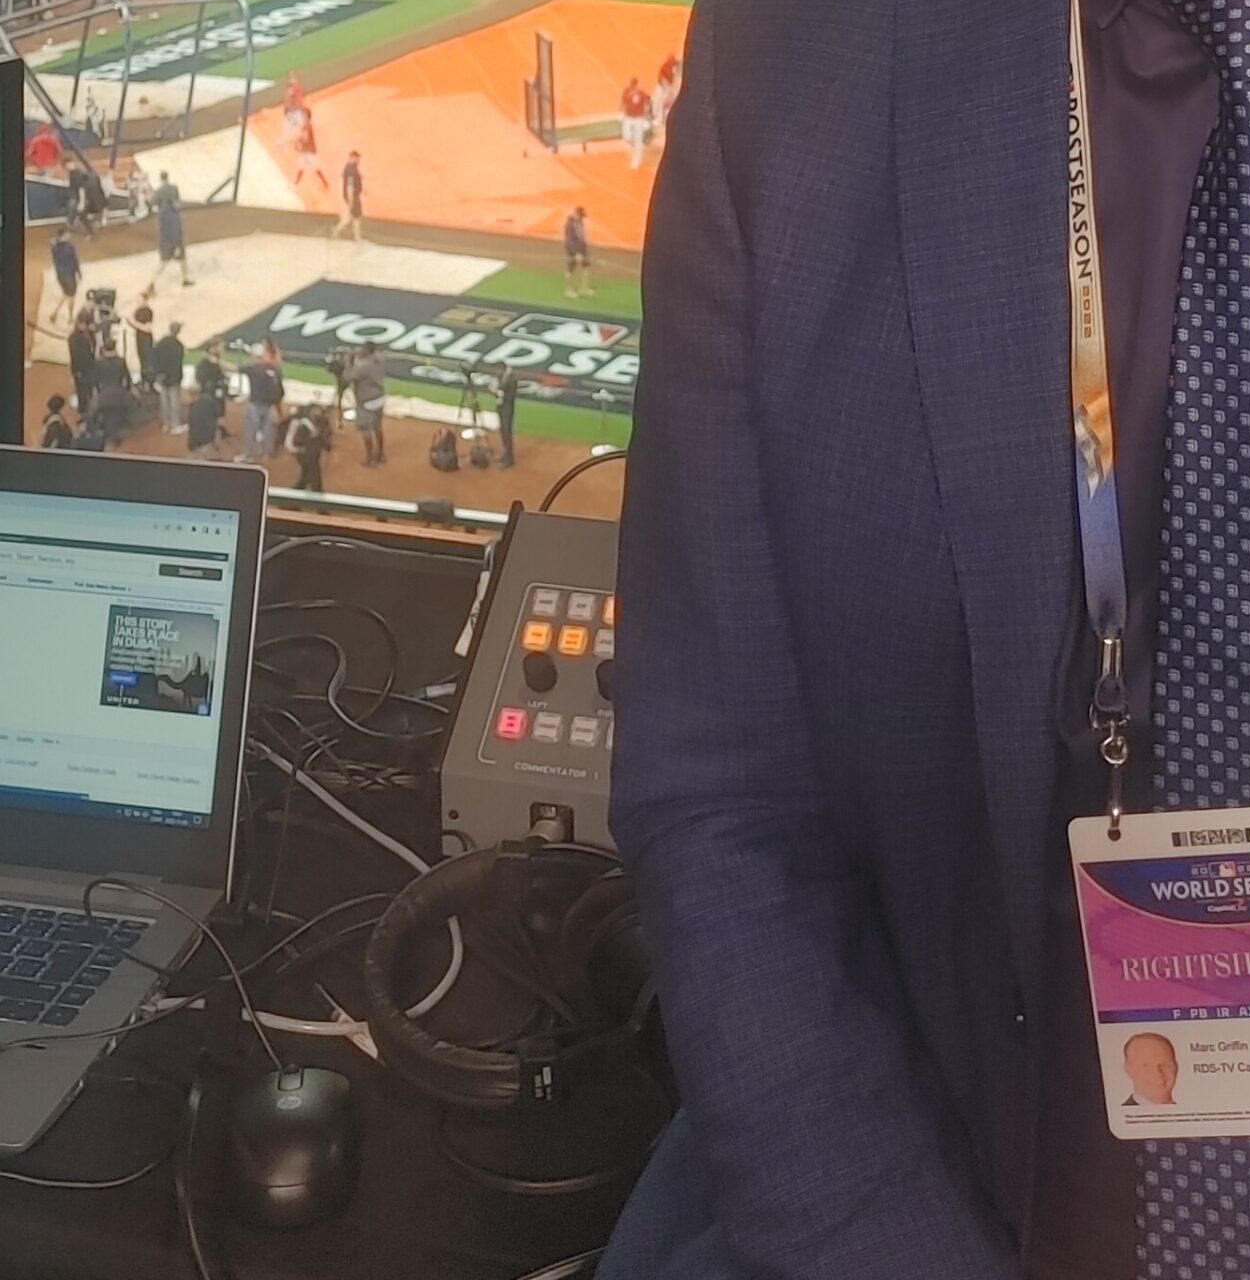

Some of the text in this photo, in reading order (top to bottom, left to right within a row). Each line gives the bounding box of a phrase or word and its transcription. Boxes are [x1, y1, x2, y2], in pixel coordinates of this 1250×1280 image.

[270, 304, 552, 367] WORLD
[115, 615, 173, 631] THIS STORY
[115, 625, 180, 642] TAKES PLACE
[112, 636, 123, 647] IN
[527, 700, 549, 709] LEFT
[514, 761, 586, 778] COMMENTATOR
[1151, 878, 1230, 901] WORLD
[1173, 1009, 1181, 1019] F
[1190, 1008, 1208, 1018] PB
[1217, 1007, 1229, 1017] IR
[1190, 1040, 1248, 1053] Marc Griffin
[1193, 1063, 1235, 1073] RDS-TV
